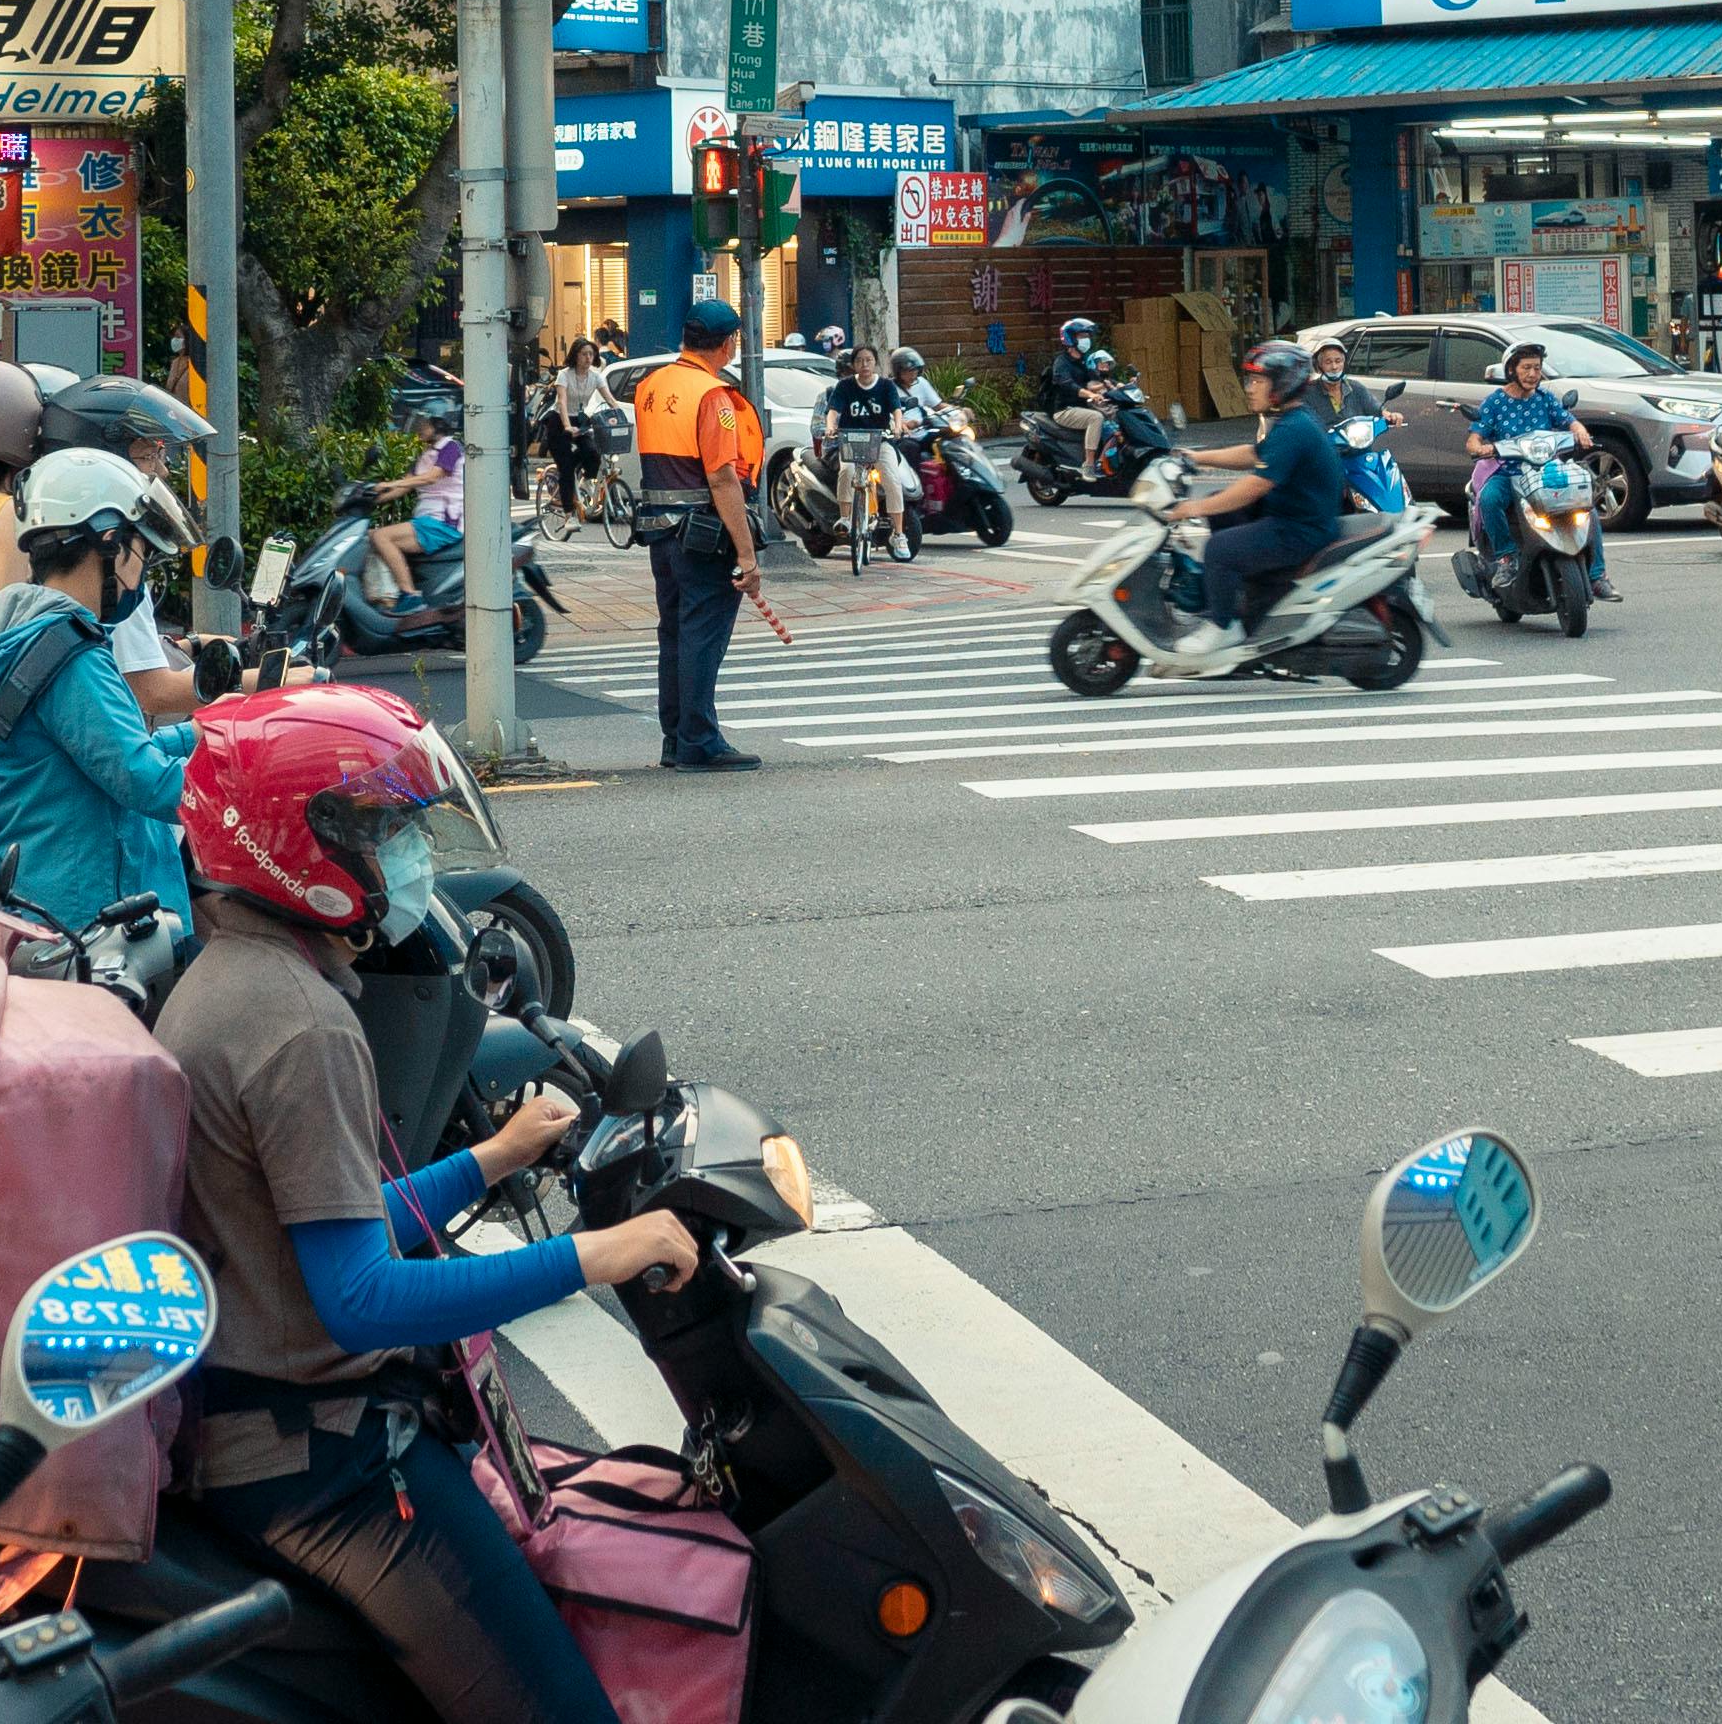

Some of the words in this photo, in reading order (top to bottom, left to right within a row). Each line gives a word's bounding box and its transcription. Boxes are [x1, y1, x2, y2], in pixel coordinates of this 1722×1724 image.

[732, 53, 763, 67] Tong
[731, 68, 756, 80] Hua
[730, 82, 746, 95] St.
[730, 98, 754, 110] Lane
[756, 98, 772, 111] 171
[773, 120, 946, 155] 阪鋼隆美家居
[819, 157, 852, 170] LUNG
[857, 157, 878, 170] MEI
[883, 158, 916, 170] HOME
[921, 159, 947, 171] LIFE
[930, 177, 985, 201] 禁止左轉
[930, 204, 985, 230] 以免受罰
[899, 221, 928, 244] 出口
[233, 824, 307, 899] foodpanda
